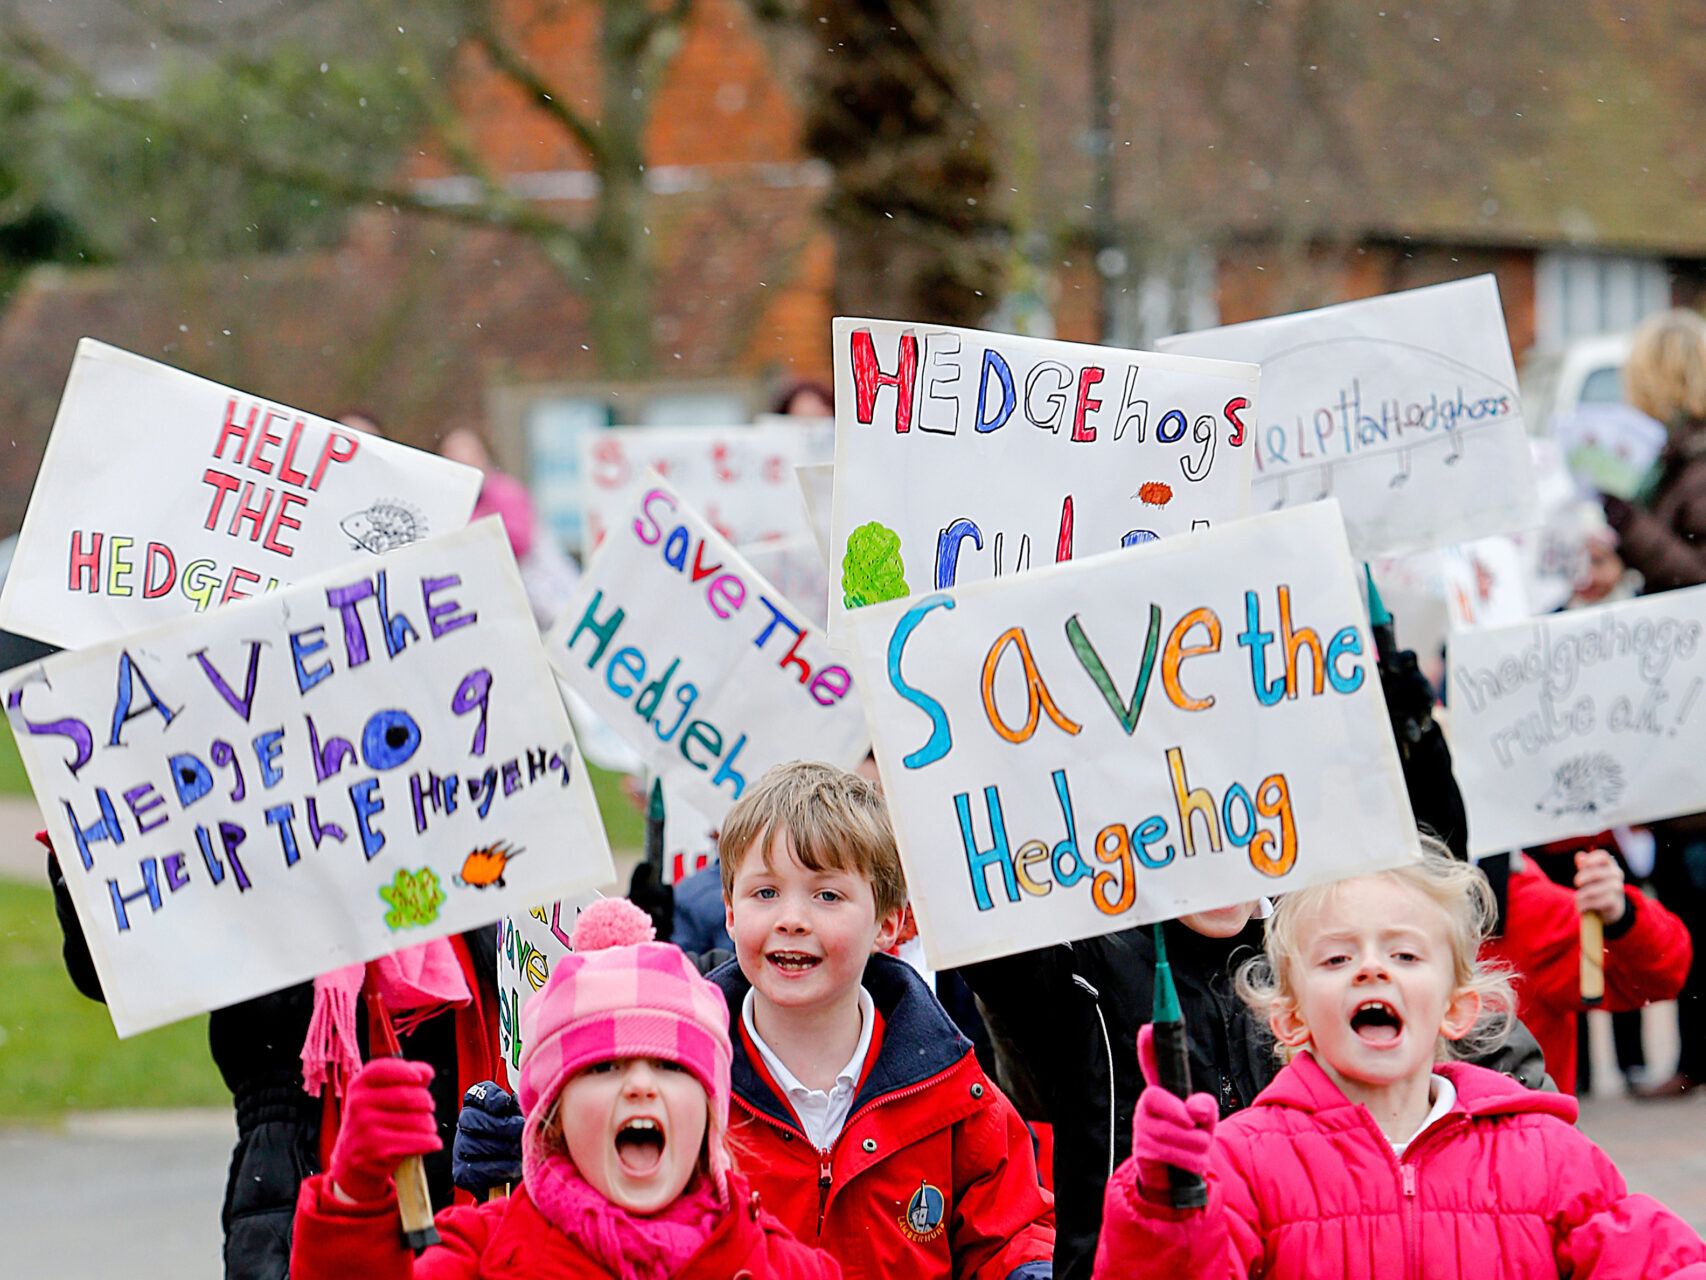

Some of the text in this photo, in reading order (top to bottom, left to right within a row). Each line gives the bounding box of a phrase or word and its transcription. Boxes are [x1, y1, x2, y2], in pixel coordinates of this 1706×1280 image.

[213, 395, 361, 493] HELP
[202, 469, 308, 557] THE
[934, 494, 1210, 592] rul
[68, 530, 294, 612] HEDGE
[634, 488, 747, 620] Save
[753, 596, 852, 706] The
[568, 589, 747, 800] Hedgeh
[1237, 584, 1366, 706] the
[4, 624, 334, 778] SAVE
[953, 746, 1298, 916] Hedgehog
[497, 916, 550, 992] ave
